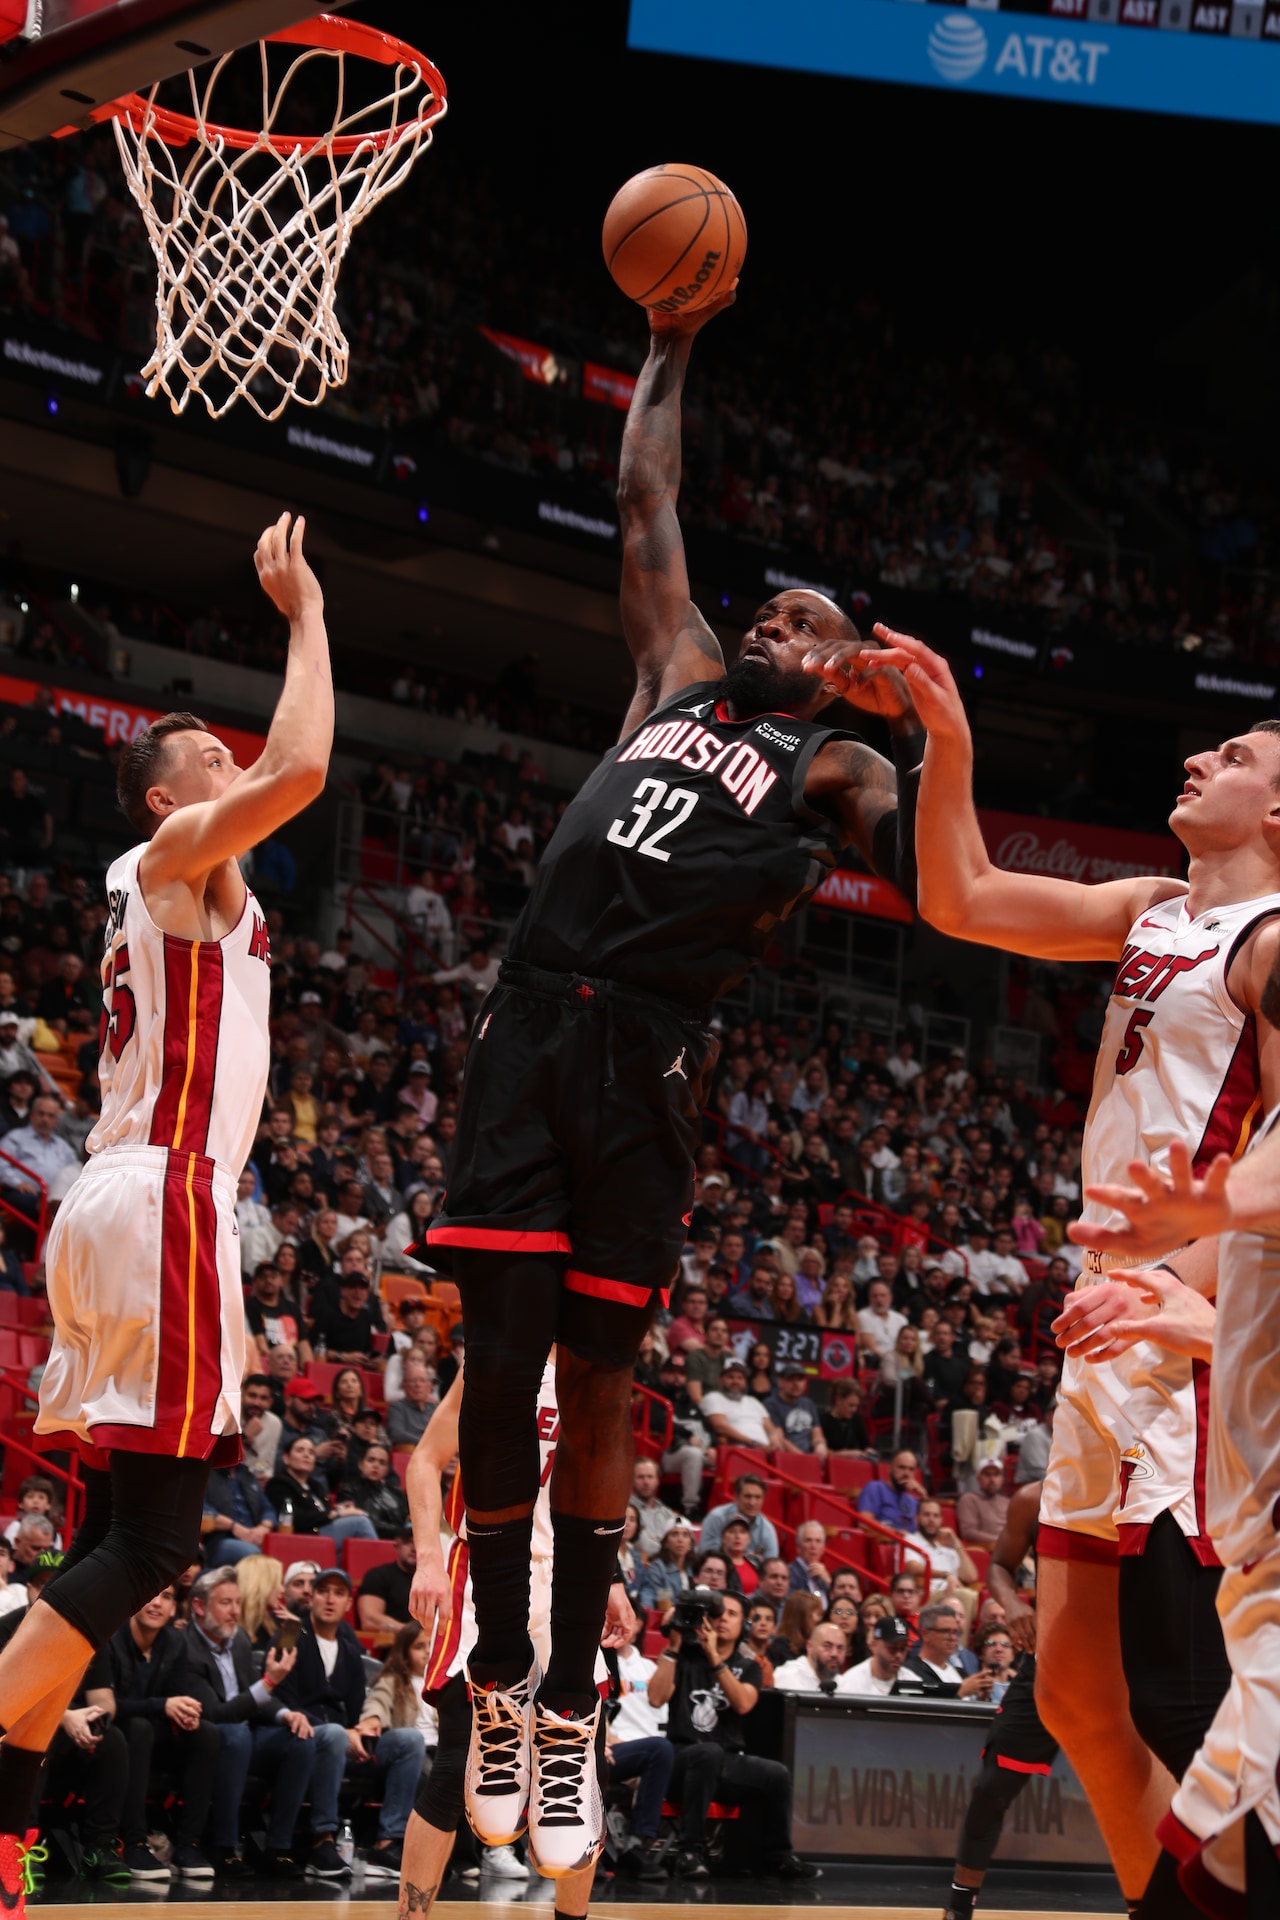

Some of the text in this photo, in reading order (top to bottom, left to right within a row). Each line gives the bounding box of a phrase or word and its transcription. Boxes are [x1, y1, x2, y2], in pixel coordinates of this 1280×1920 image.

[1123, 1, 1156, 22] AST
[1194, 5, 1227, 29] AST
[994, 33, 1109, 85] AT&T
[650, 250, 721, 313] Wilson
[616, 719, 778, 817] HOUSTON
[755, 725, 796, 752] karma
[606, 777, 700, 862] 32
[996, 832, 1088, 882] Bally
[1115, 1007, 1156, 1076] 5
[806, 1764, 843, 1826] LA
[852, 1767, 916, 1828] VIDA
[926, 1763, 979, 1830] MÁ
